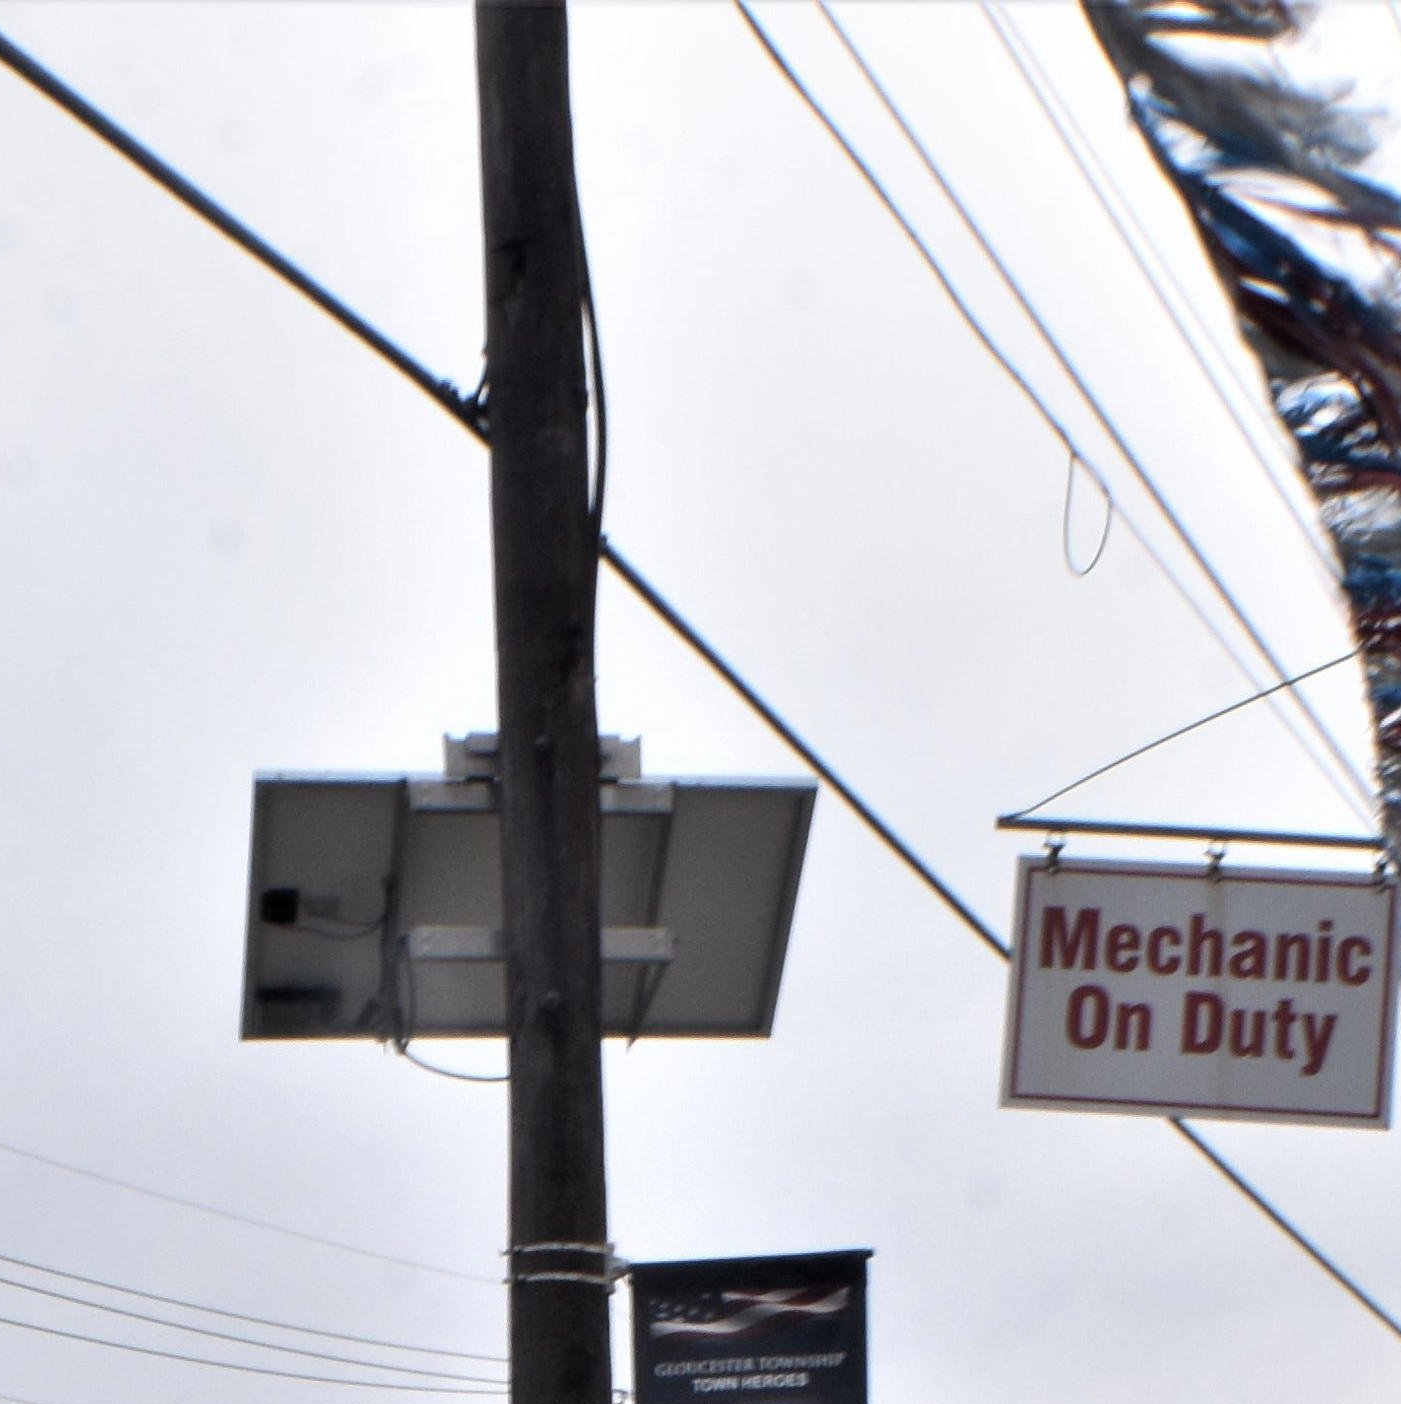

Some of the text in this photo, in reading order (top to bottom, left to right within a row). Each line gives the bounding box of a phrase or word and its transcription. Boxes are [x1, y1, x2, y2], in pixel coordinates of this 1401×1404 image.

[1039, 905, 1375, 987] Mechanic
[1065, 984, 1338, 1078] On Duty
[654, 1351, 848, 1377] GLOUCESTER TOWNSHIP
[692, 1371, 811, 1395] TOWN HEROES
